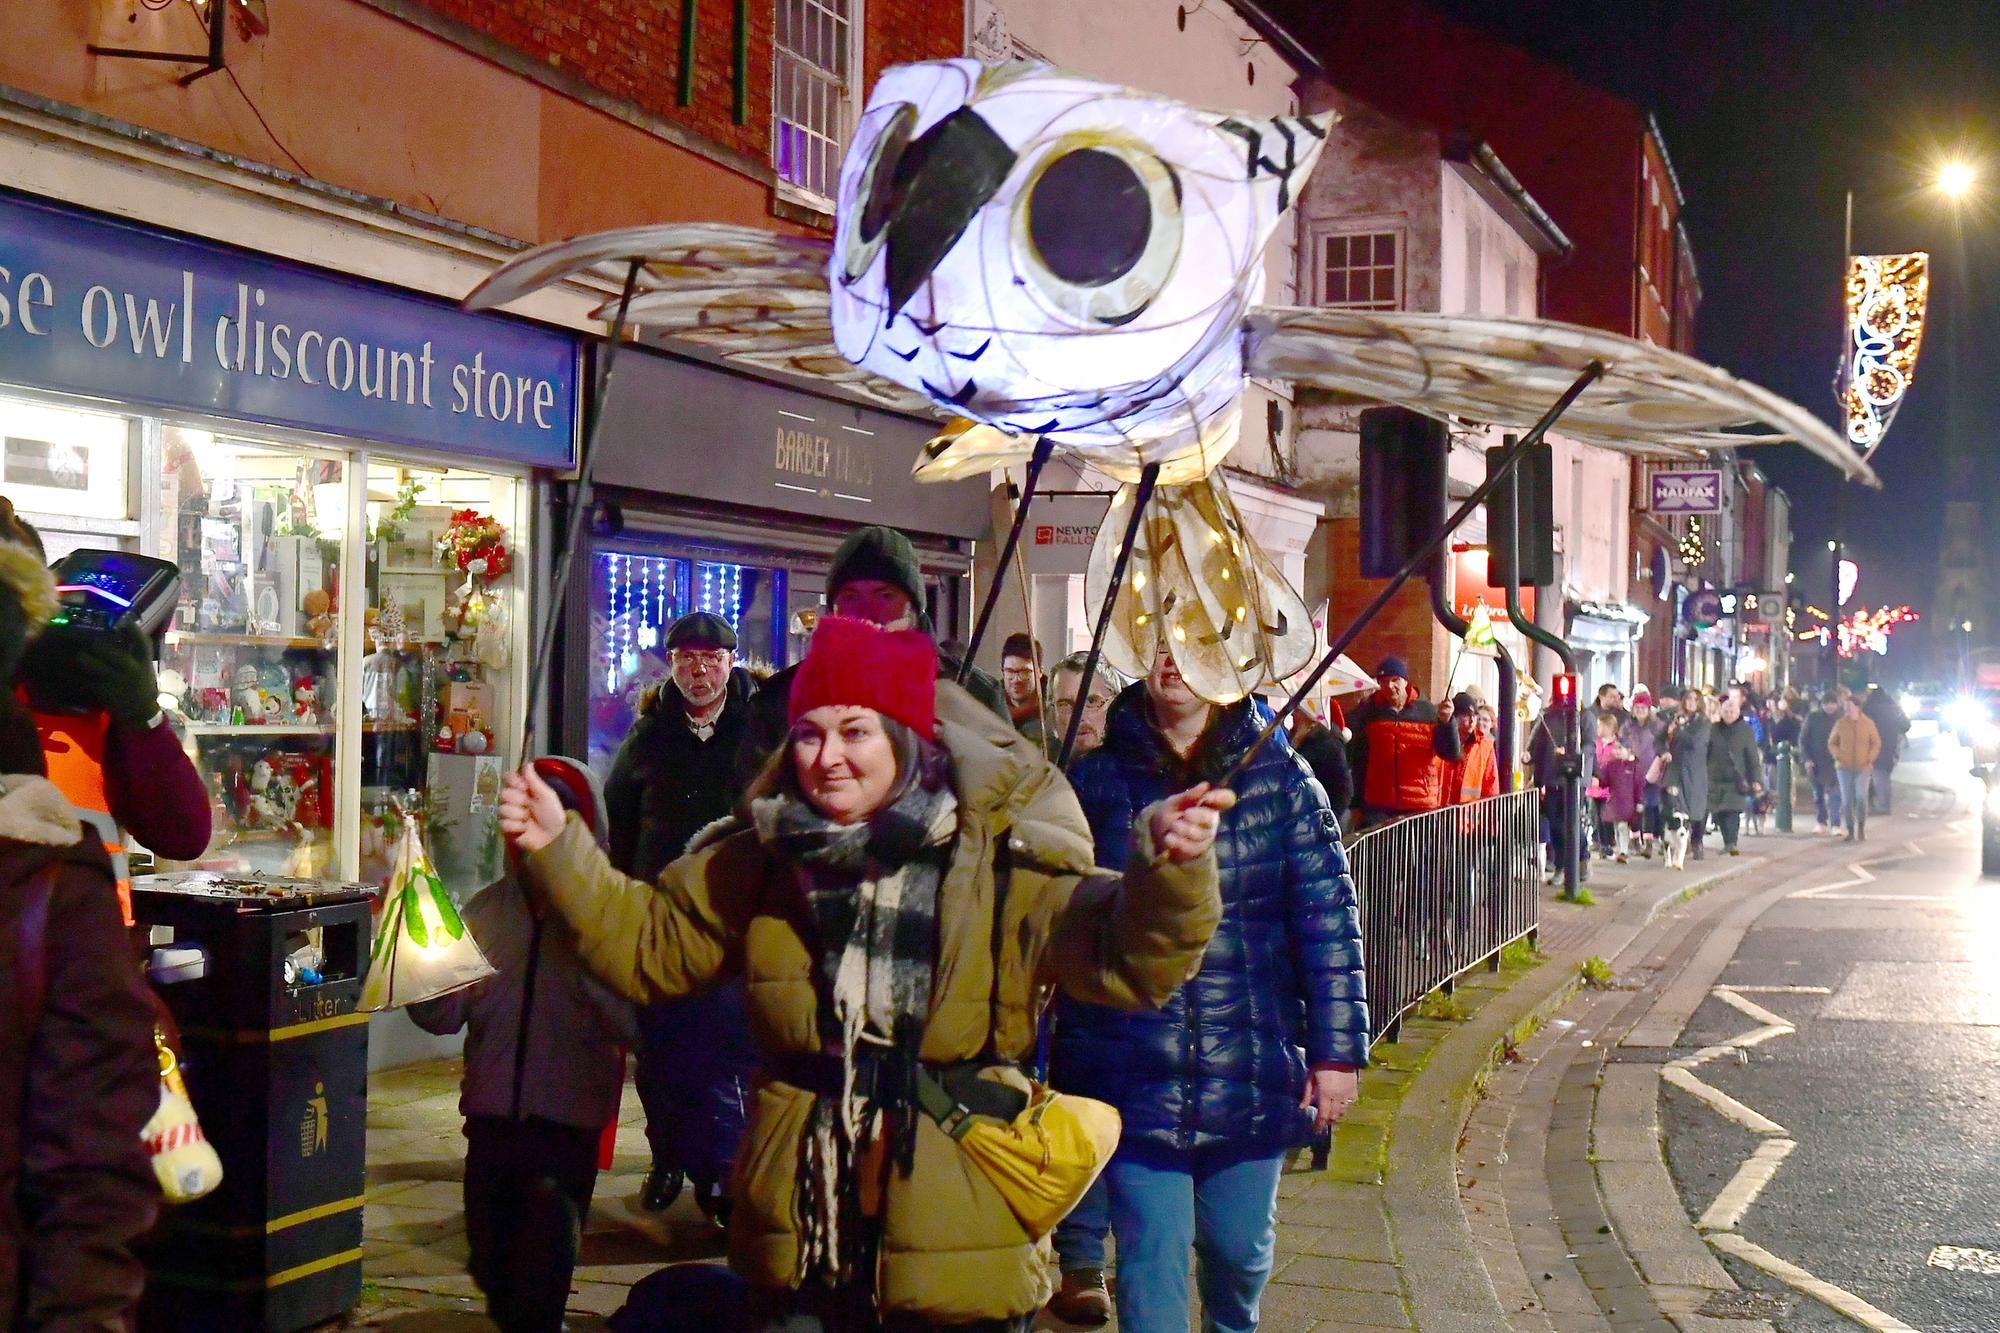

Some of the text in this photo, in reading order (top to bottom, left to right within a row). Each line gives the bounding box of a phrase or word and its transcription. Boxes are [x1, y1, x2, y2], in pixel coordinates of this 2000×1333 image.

[81, 271, 194, 363] owl
[215, 283, 434, 408] discount
[452, 351, 554, 430] store
[1656, 486, 1715, 499] HALIFAX
[1056, 526, 1099, 536] NEWTO
[1056, 535, 1096, 545] FALLO
